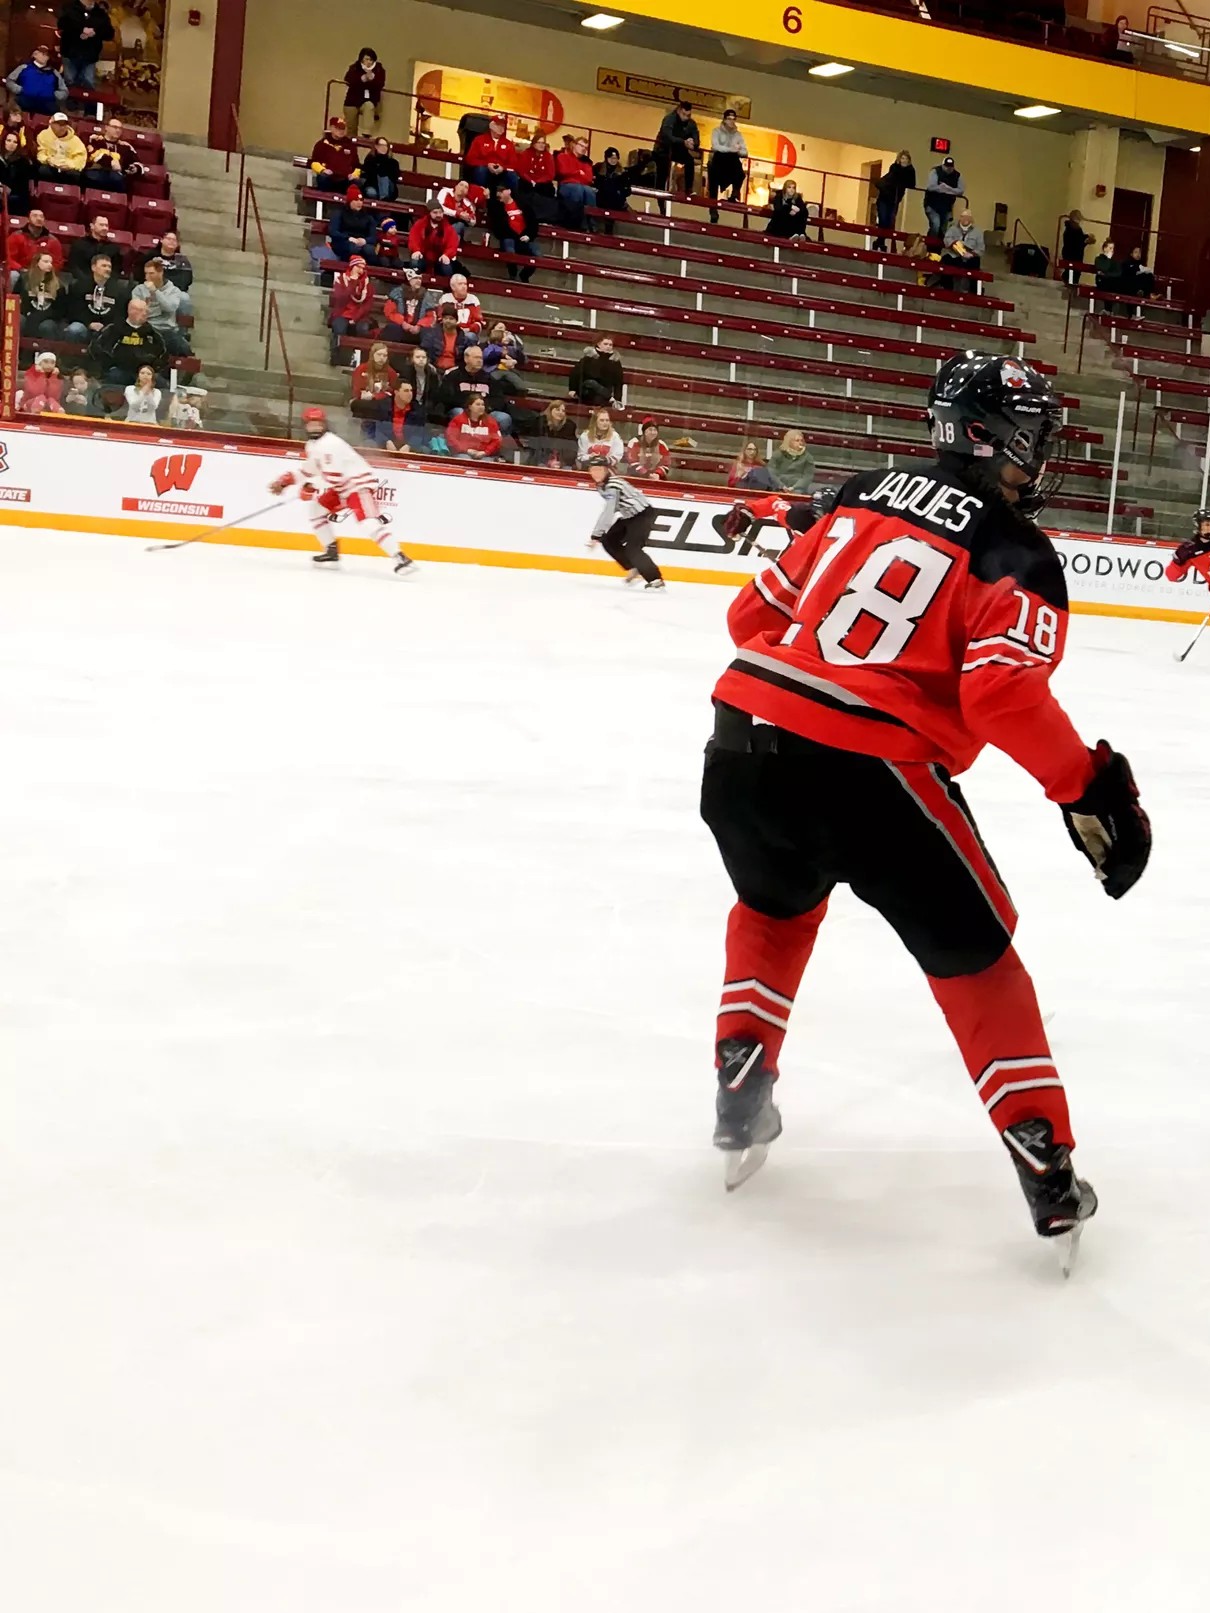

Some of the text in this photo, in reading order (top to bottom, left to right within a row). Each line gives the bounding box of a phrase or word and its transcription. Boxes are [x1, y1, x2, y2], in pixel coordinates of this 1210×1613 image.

[783, 6, 802, 34] 6
[937, 420, 955, 444] 18
[137, 500, 210, 516] WISCONSIN
[860, 471, 983, 533] JAQUES
[780, 517, 955, 667] 18
[1006, 590, 1059, 655] 18
